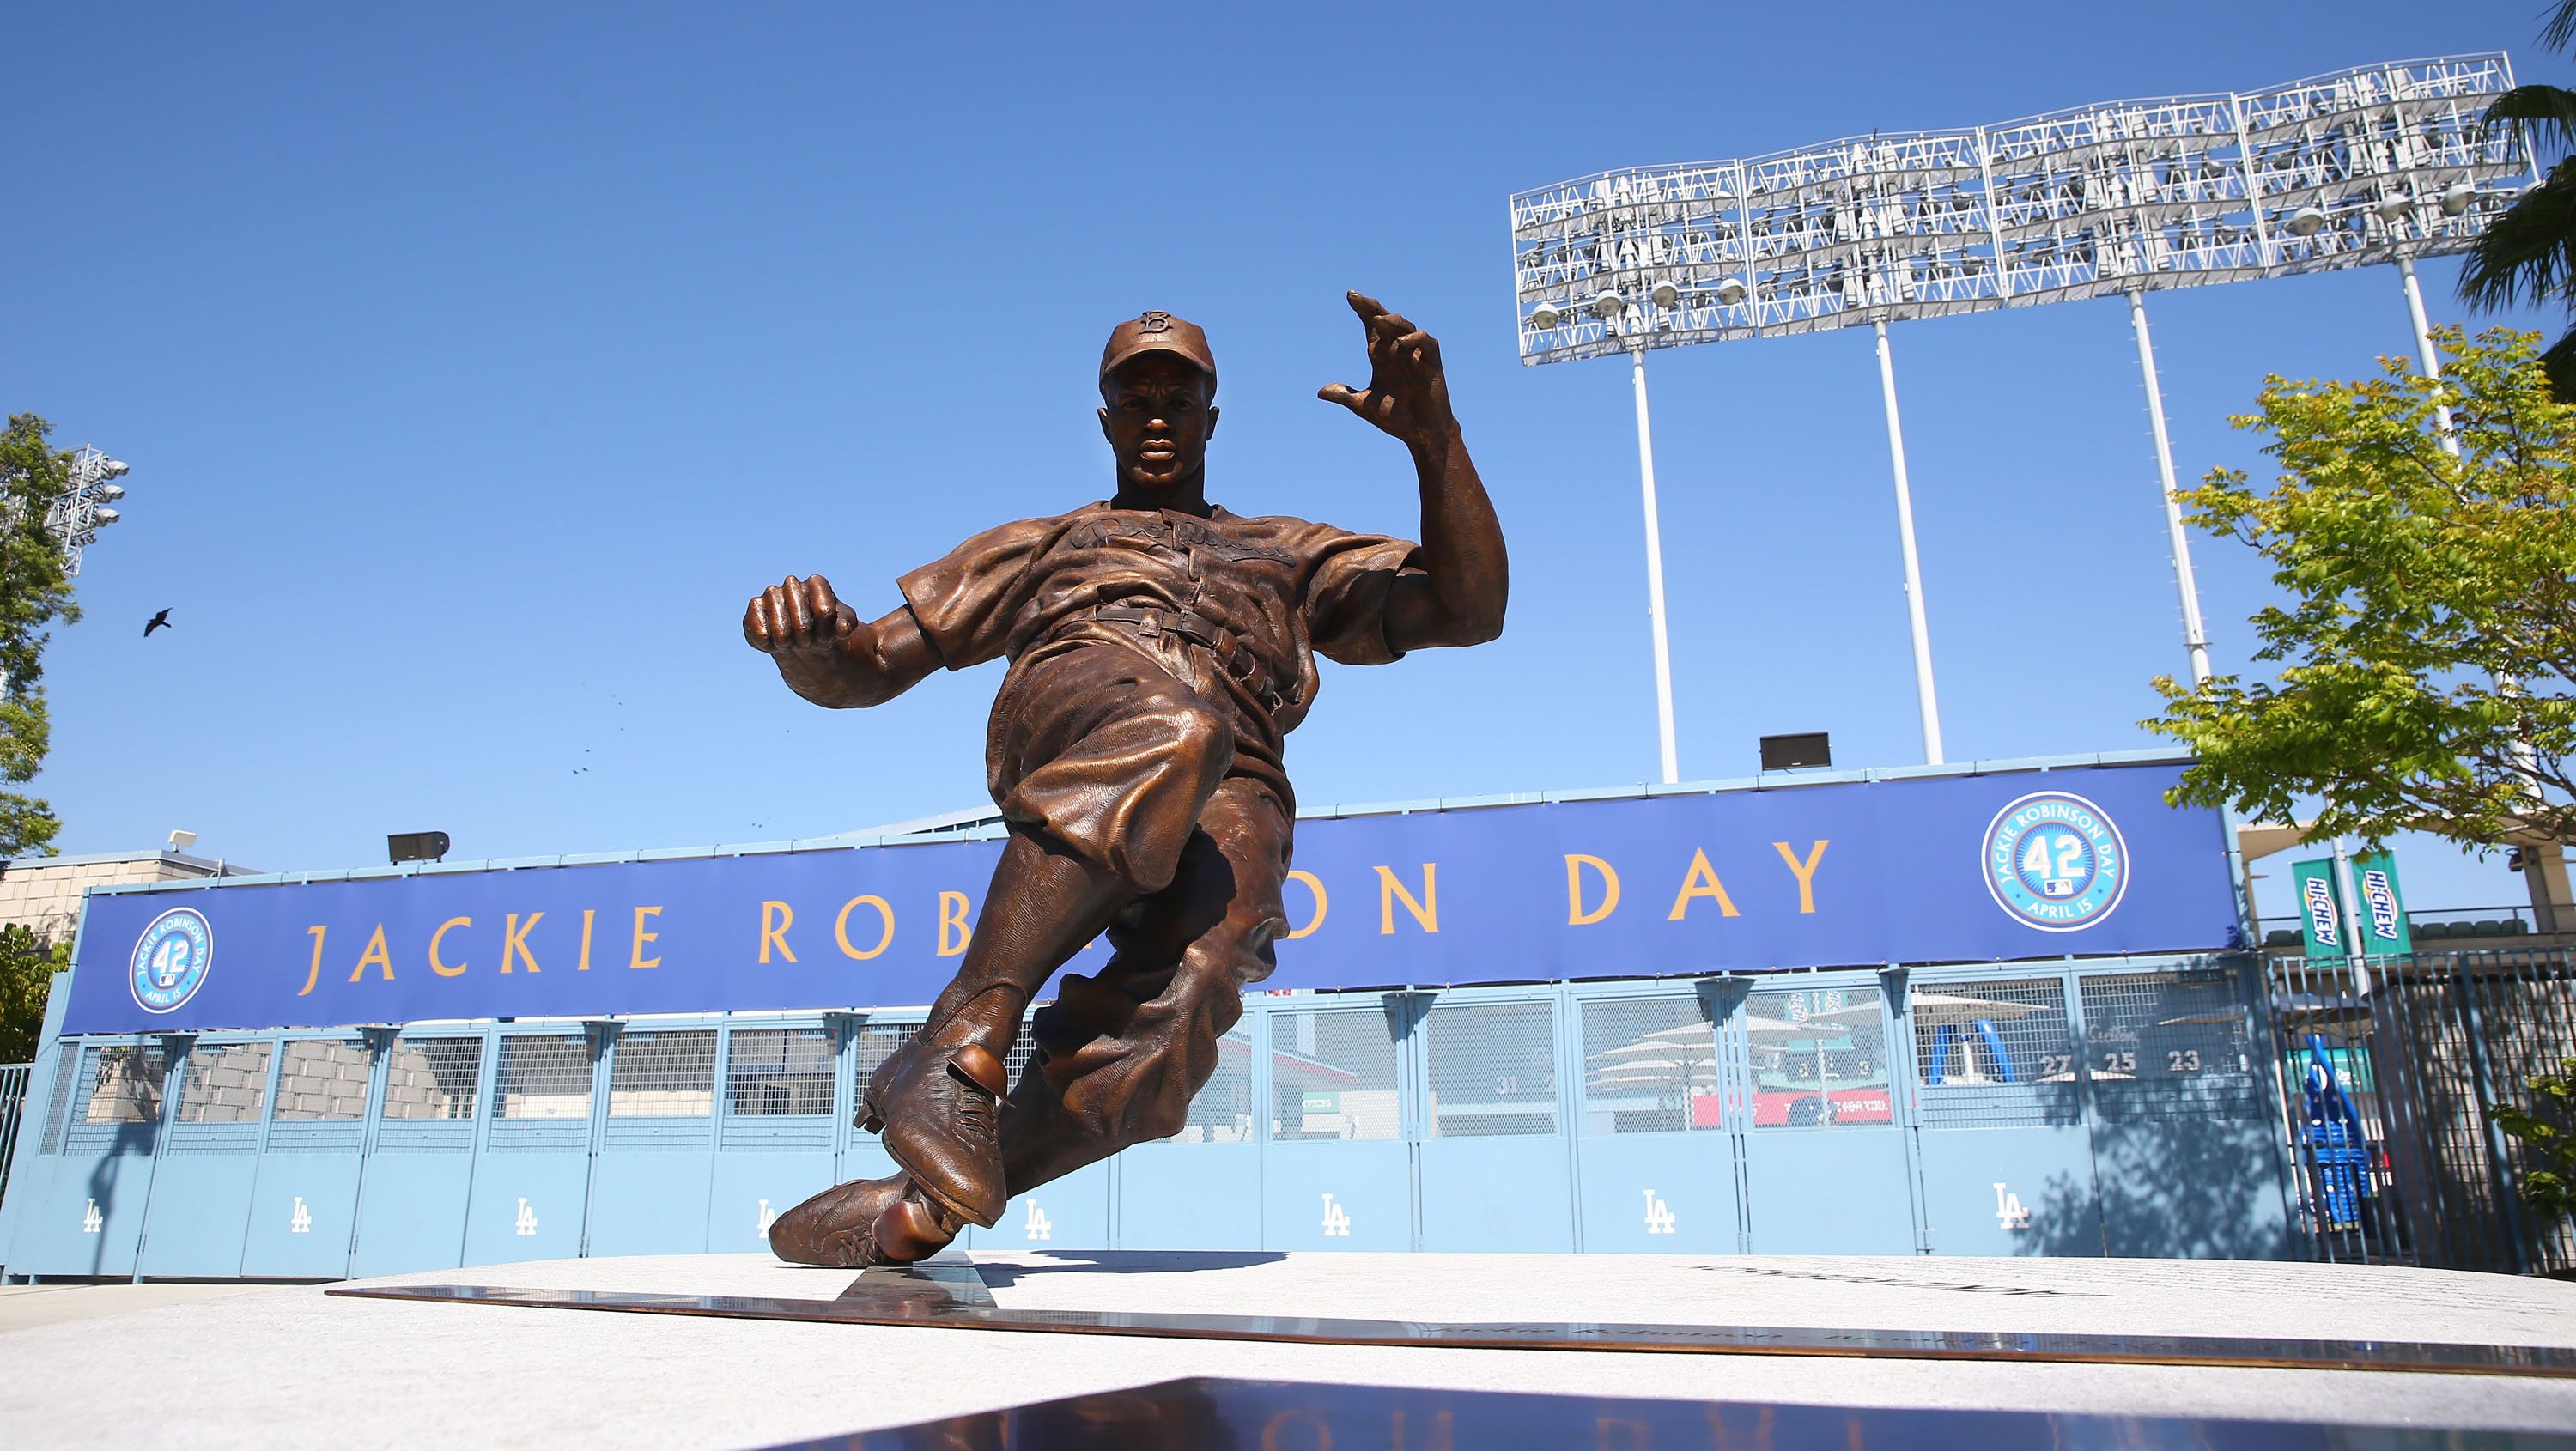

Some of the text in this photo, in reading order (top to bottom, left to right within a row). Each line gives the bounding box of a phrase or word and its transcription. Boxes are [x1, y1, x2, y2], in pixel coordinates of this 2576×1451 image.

[1139, 310, 1173, 335] B
[1995, 804, 2116, 885] JACKIE ROBINSON DAY
[2022, 835, 2086, 879] 42
[299, 906, 663, 997] JACKIE
[1564, 839, 1829, 926] DAY
[2026, 897, 2093, 919] APRIL 15
[2306, 877, 2337, 946] HI-CHEW
[2365, 870, 2398, 940] HI-CHEW
[137, 917, 205, 977] JACKIE ROBINSON DAY
[152, 939, 190, 974] 42
[145, 987, 182, 1004] APRIL 15
[2040, 1054, 2071, 1074] 27
[2104, 1052, 2136, 1072] 25
[2167, 1050, 2200, 1071] 23
[83, 1198, 103, 1233] LA
[291, 1196, 312, 1233] LA
[515, 1197, 538, 1236] LA
[1025, 1199, 1052, 1241] LA
[1321, 1193, 1351, 1237] LA
[1643, 1188, 1676, 1235] LA
[1993, 1181, 2030, 1230] LA
